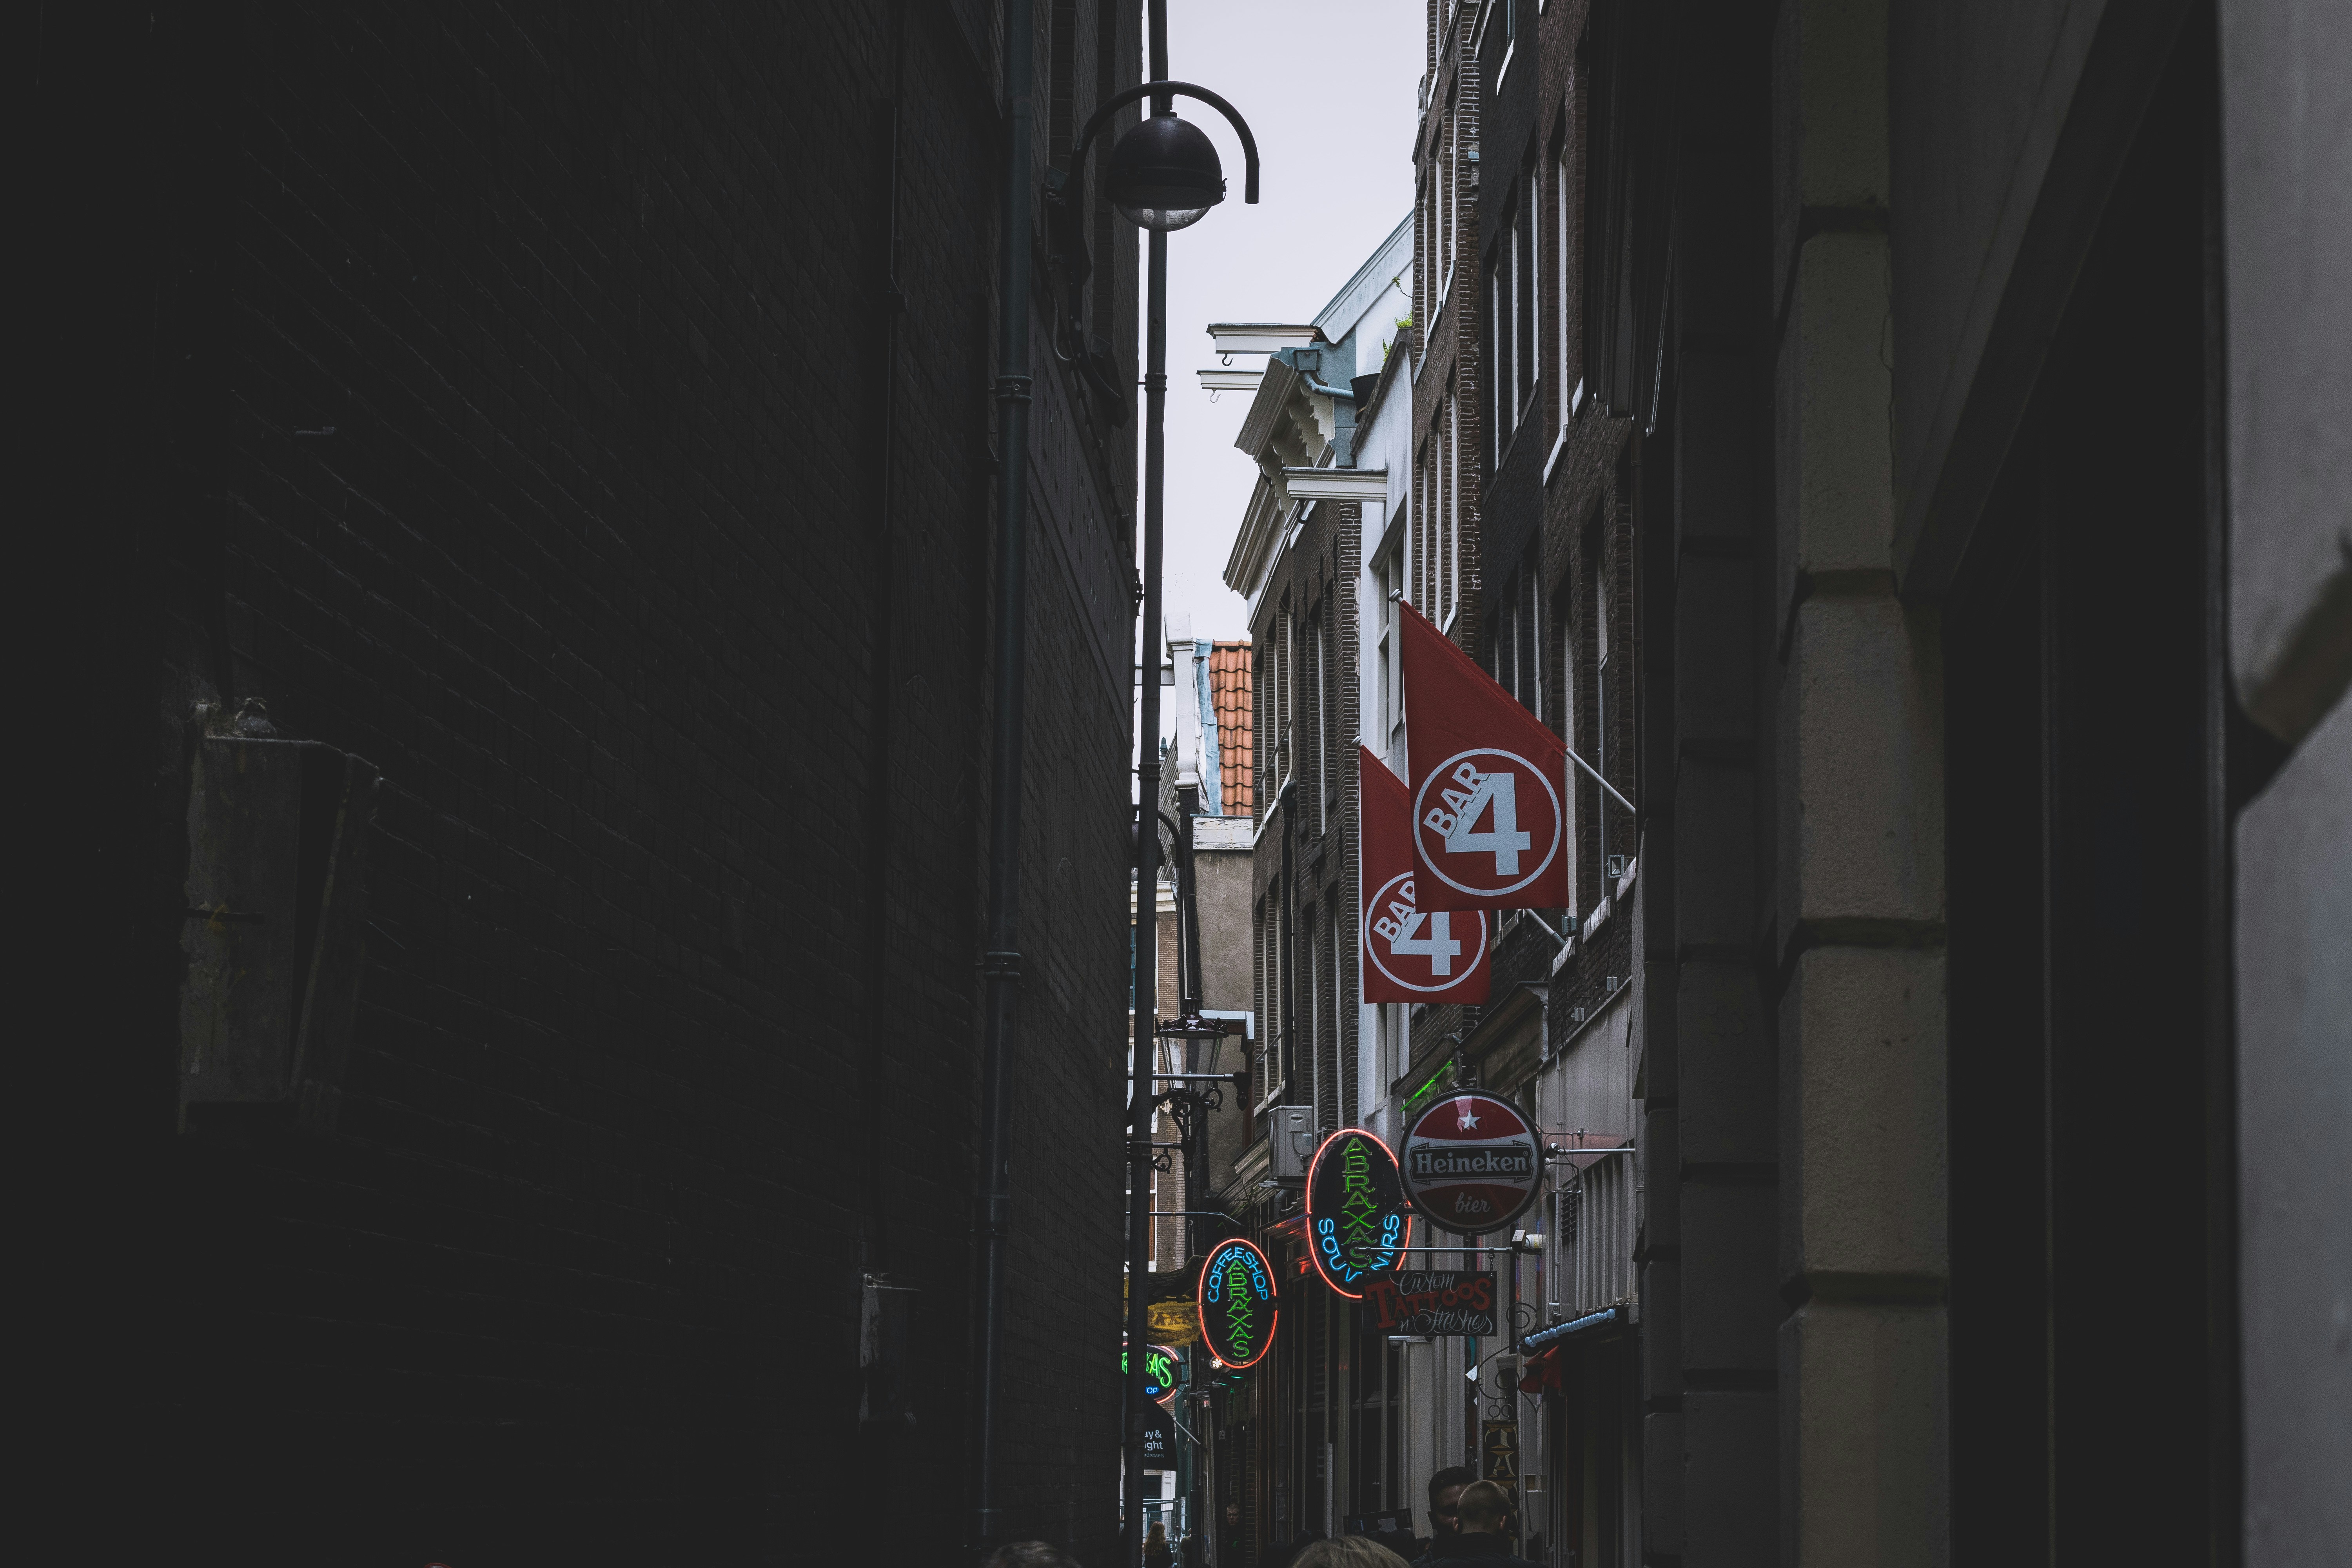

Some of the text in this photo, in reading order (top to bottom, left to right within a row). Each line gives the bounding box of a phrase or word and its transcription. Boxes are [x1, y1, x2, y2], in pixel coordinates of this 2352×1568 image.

[1423, 762, 1530, 875] BAR 4
[1391, 911, 1461, 975] 4
[1416, 1151, 1528, 1174] Heineken
[1341, 1138, 1377, 1268] ABRAXAS
[1455, 1192, 1490, 1213] bier
[1208, 1247, 1268, 1302] COFFEESHOP
[1318, 1214, 1399, 1283] SOUVNIRS
[1225, 1259, 1253, 1357] ABRAXAS
[1389, 1272, 1459, 1295] Custom
[1414, 1303, 1492, 1334] Flashes
[1155, 1430, 1162, 1438] &
